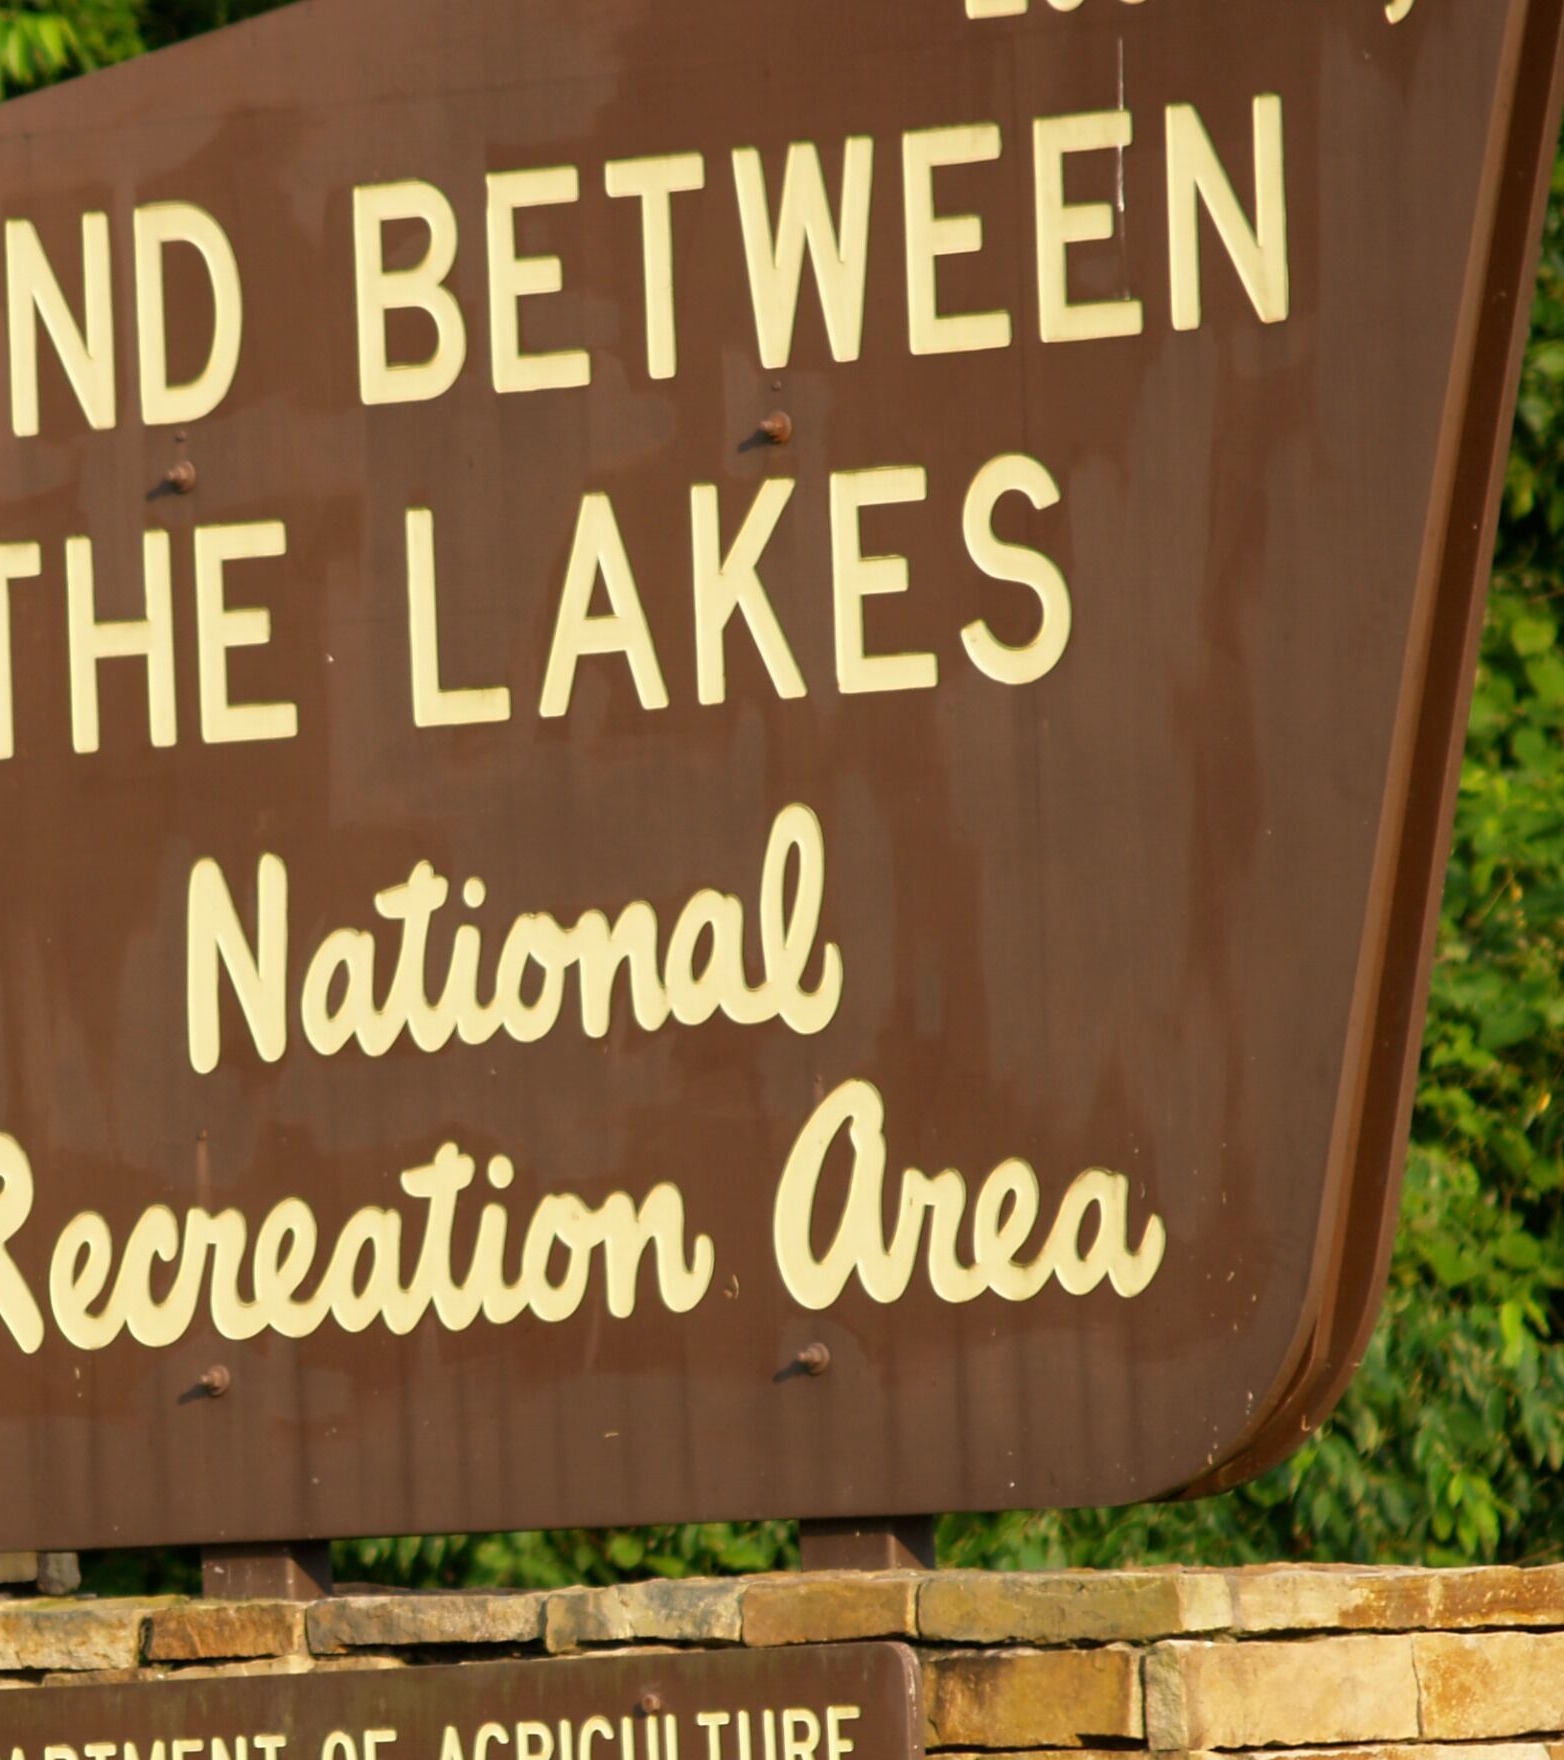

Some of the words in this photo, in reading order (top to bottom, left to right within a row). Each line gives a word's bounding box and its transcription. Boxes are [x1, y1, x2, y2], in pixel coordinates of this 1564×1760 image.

[352, 96, 1289, 407] BETWEEN
[404, 454, 1072, 729] LAKES
[186, 805, 843, 1076] National
[772, 1080, 1165, 1311] Area
